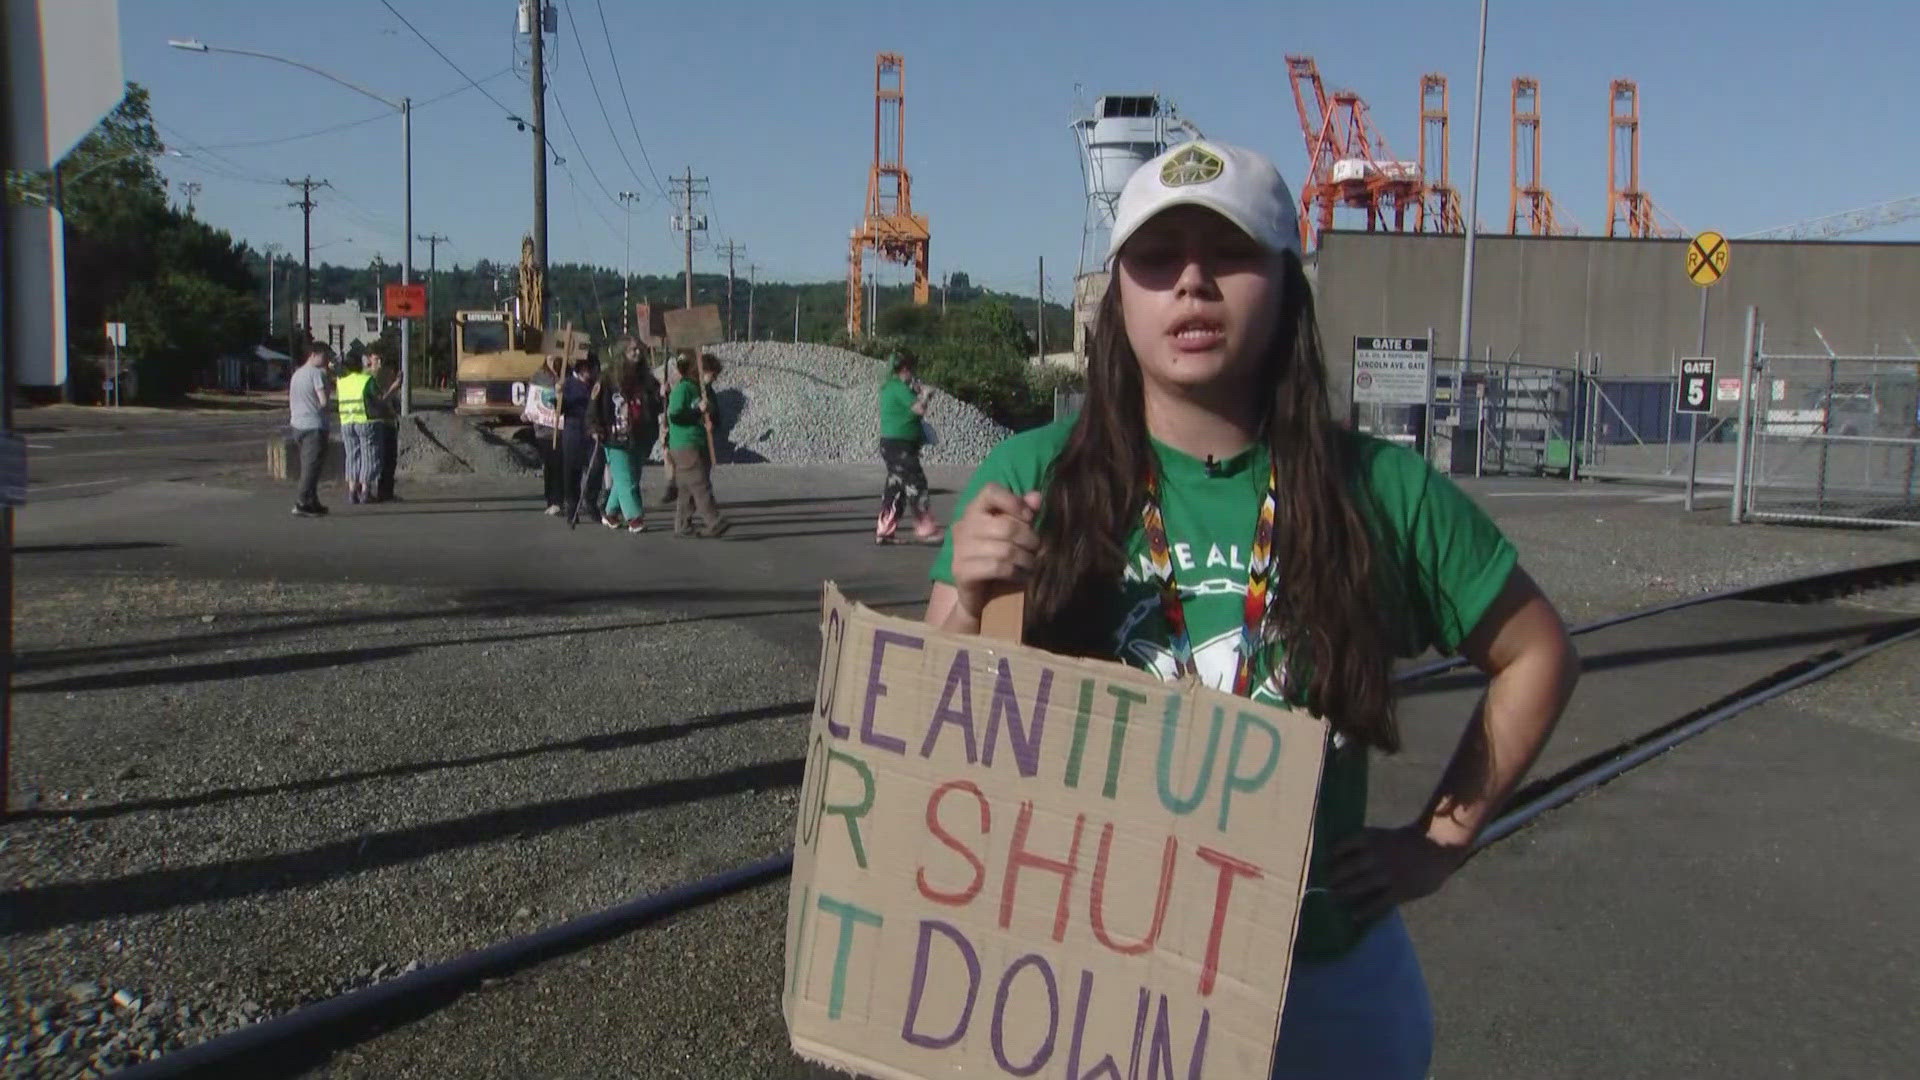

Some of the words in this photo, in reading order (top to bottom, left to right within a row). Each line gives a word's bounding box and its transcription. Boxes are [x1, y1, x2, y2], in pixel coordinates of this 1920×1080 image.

[1371, 338, 1402, 350] GATE
[1405, 339, 1413, 350] 5
[1357, 361, 1388, 369] LINCOLN
[1408, 362, 1425, 370] GATE
[1684, 362, 1712, 374] GATE
[1687, 378, 1704, 406] 5
[820, 607, 1054, 778] CLEAN
[1064, 679, 1147, 800] IT
[1156, 692, 1281, 833] UP
[803, 733, 875, 870] OR
[916, 780, 1265, 997] SHUT
[791, 886, 884, 1020] IT
[902, 920, 1210, 1080] DOWN
